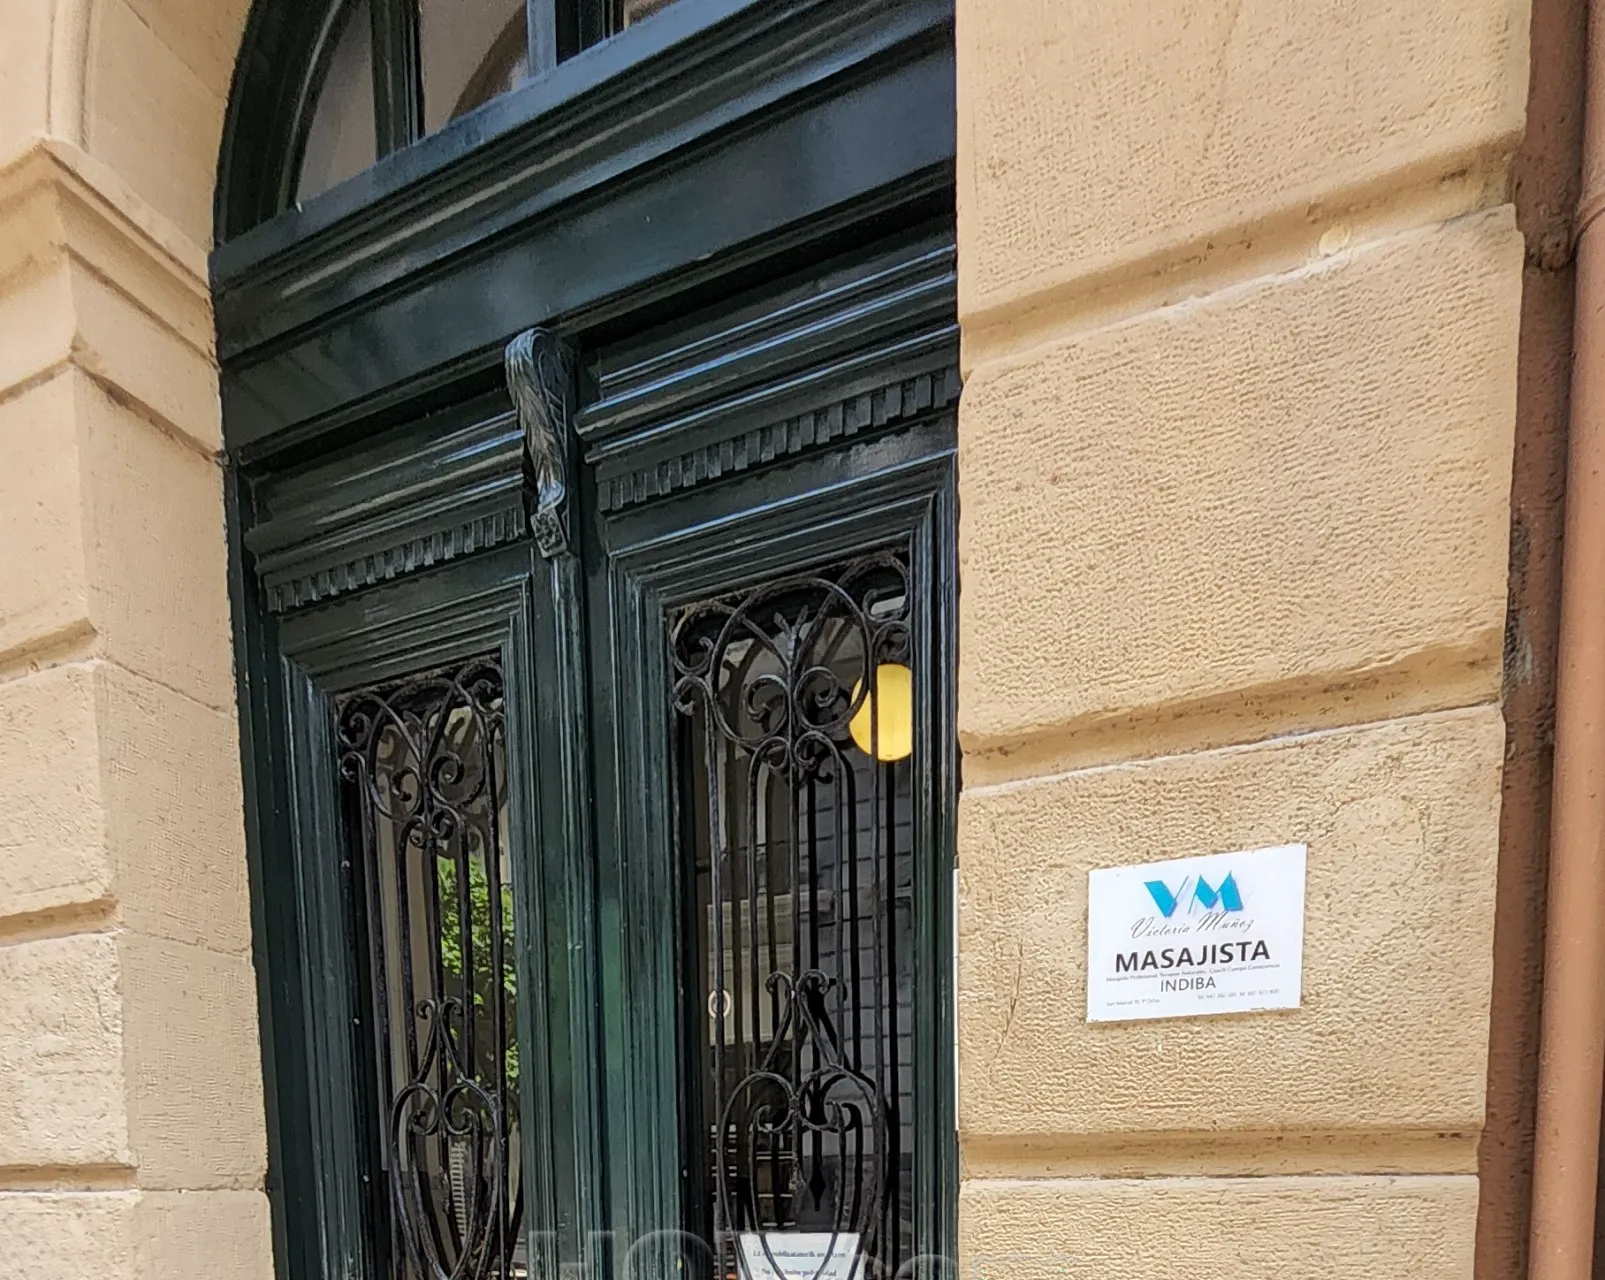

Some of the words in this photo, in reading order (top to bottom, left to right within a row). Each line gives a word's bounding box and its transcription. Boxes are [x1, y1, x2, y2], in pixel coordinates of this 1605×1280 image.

[1143, 870, 1244, 918] VM
[1130, 916, 1190, 939] Victoria
[1115, 939, 1271, 973] MASAJISTA
[1160, 976, 1216, 992] INDIBA
